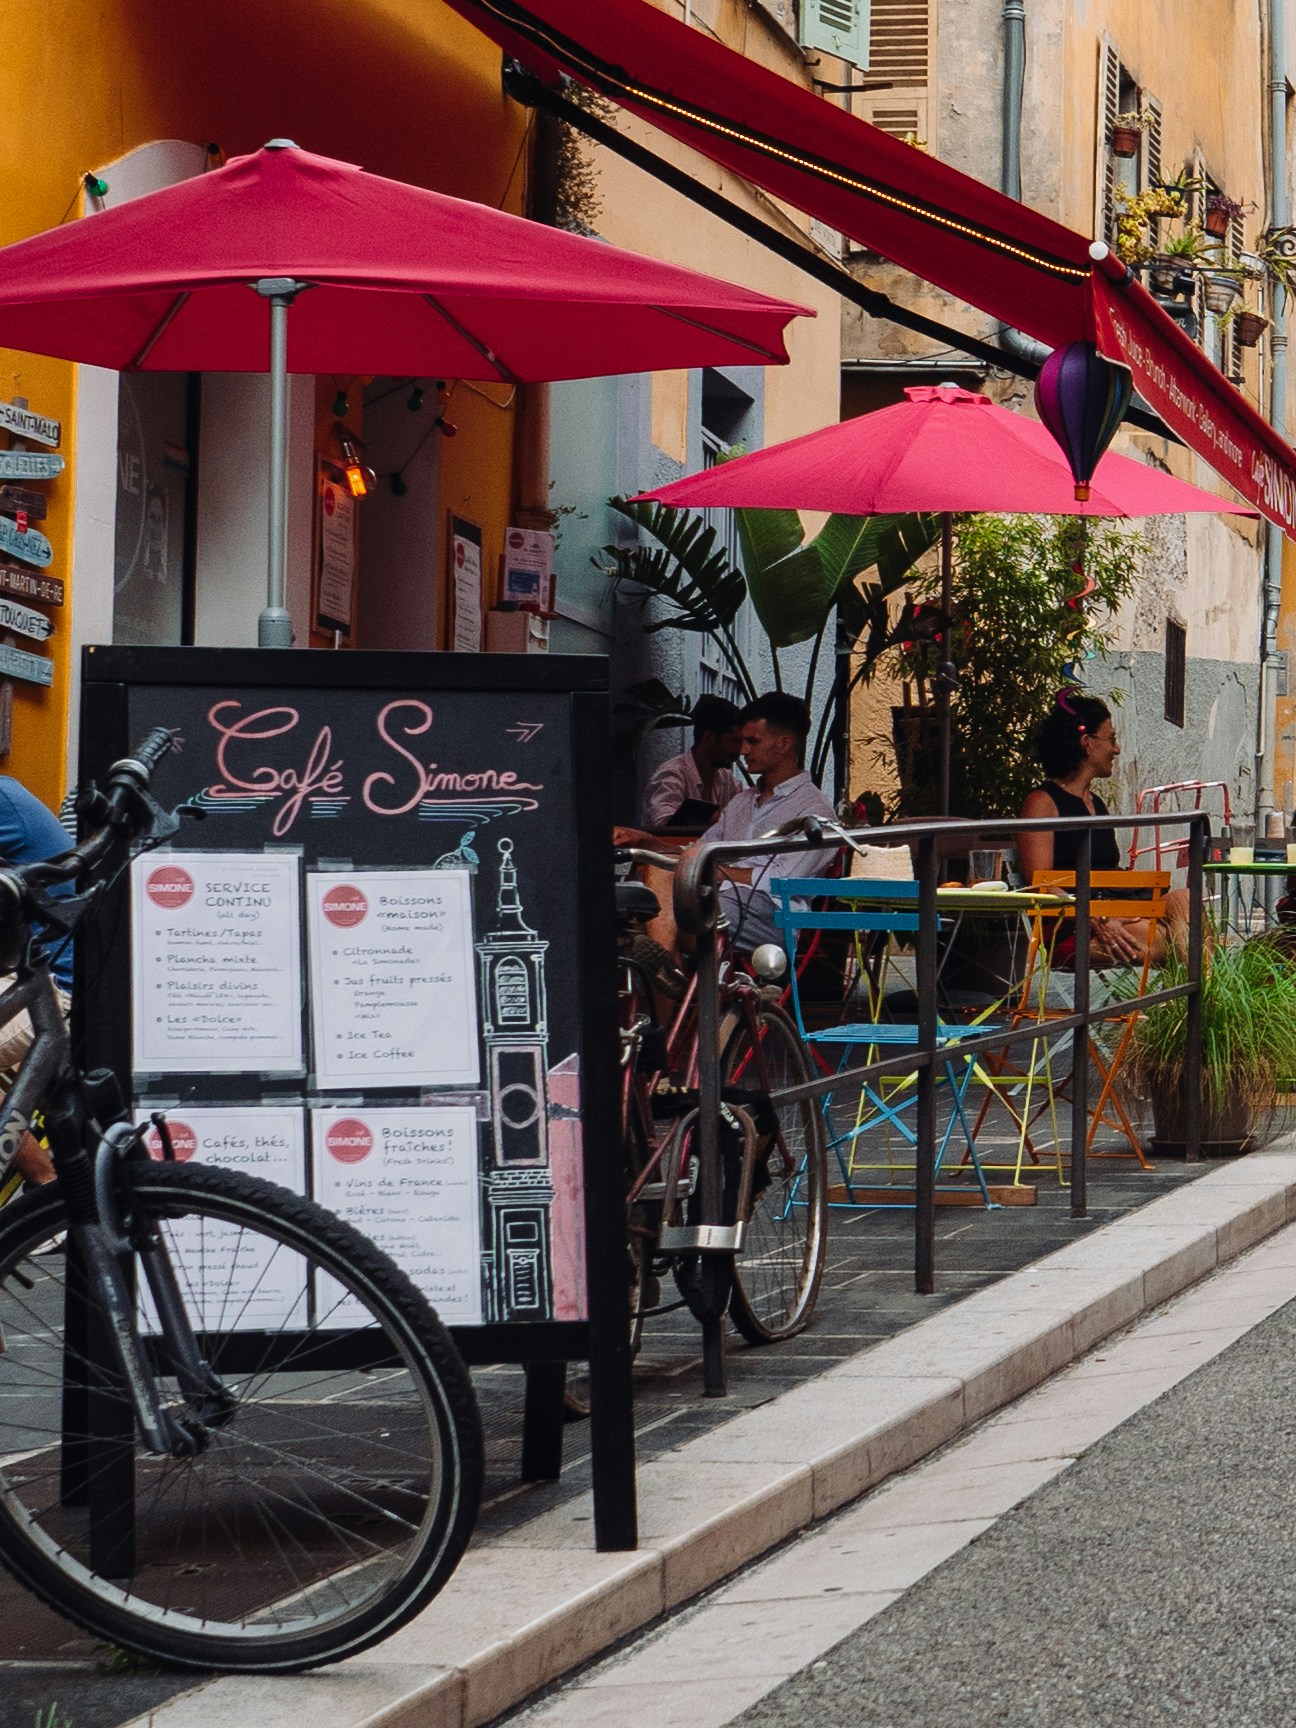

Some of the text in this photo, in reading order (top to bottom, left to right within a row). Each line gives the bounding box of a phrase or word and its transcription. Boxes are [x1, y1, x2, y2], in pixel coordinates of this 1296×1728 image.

[5, 407, 59, 441] SAINT-MALO
[208, 699, 544, 836] Café Simone
[149, 883, 193, 894] SIMONE
[205, 882, 271, 894] SERVICE
[205, 896, 272, 908] CONTINU
[324, 901, 368, 913] SIMONE
[379, 895, 443, 907] Boissons
[238, 911, 261, 922] day)
[166, 928, 263, 940] Tartines/Tapas
[343, 944, 413, 956] Citronnade
[167, 954, 257, 964] Plancha mixte
[166, 980, 258, 991] Plaisirs divins
[344, 972, 453, 988] Jus fruits pressés
[347, 1030, 392, 1040] Ice Tea
[349, 1047, 416, 1060] Ice Coffee
[382, 1127, 454, 1139] Boissons
[203, 1135, 290, 1151] Cafés, thés,
[327, 1136, 372, 1148] SIMONE
[346, 1178, 373, 1188] Vins
[378, 1177, 394, 1187] de
[400, 1177, 443, 1187] France
